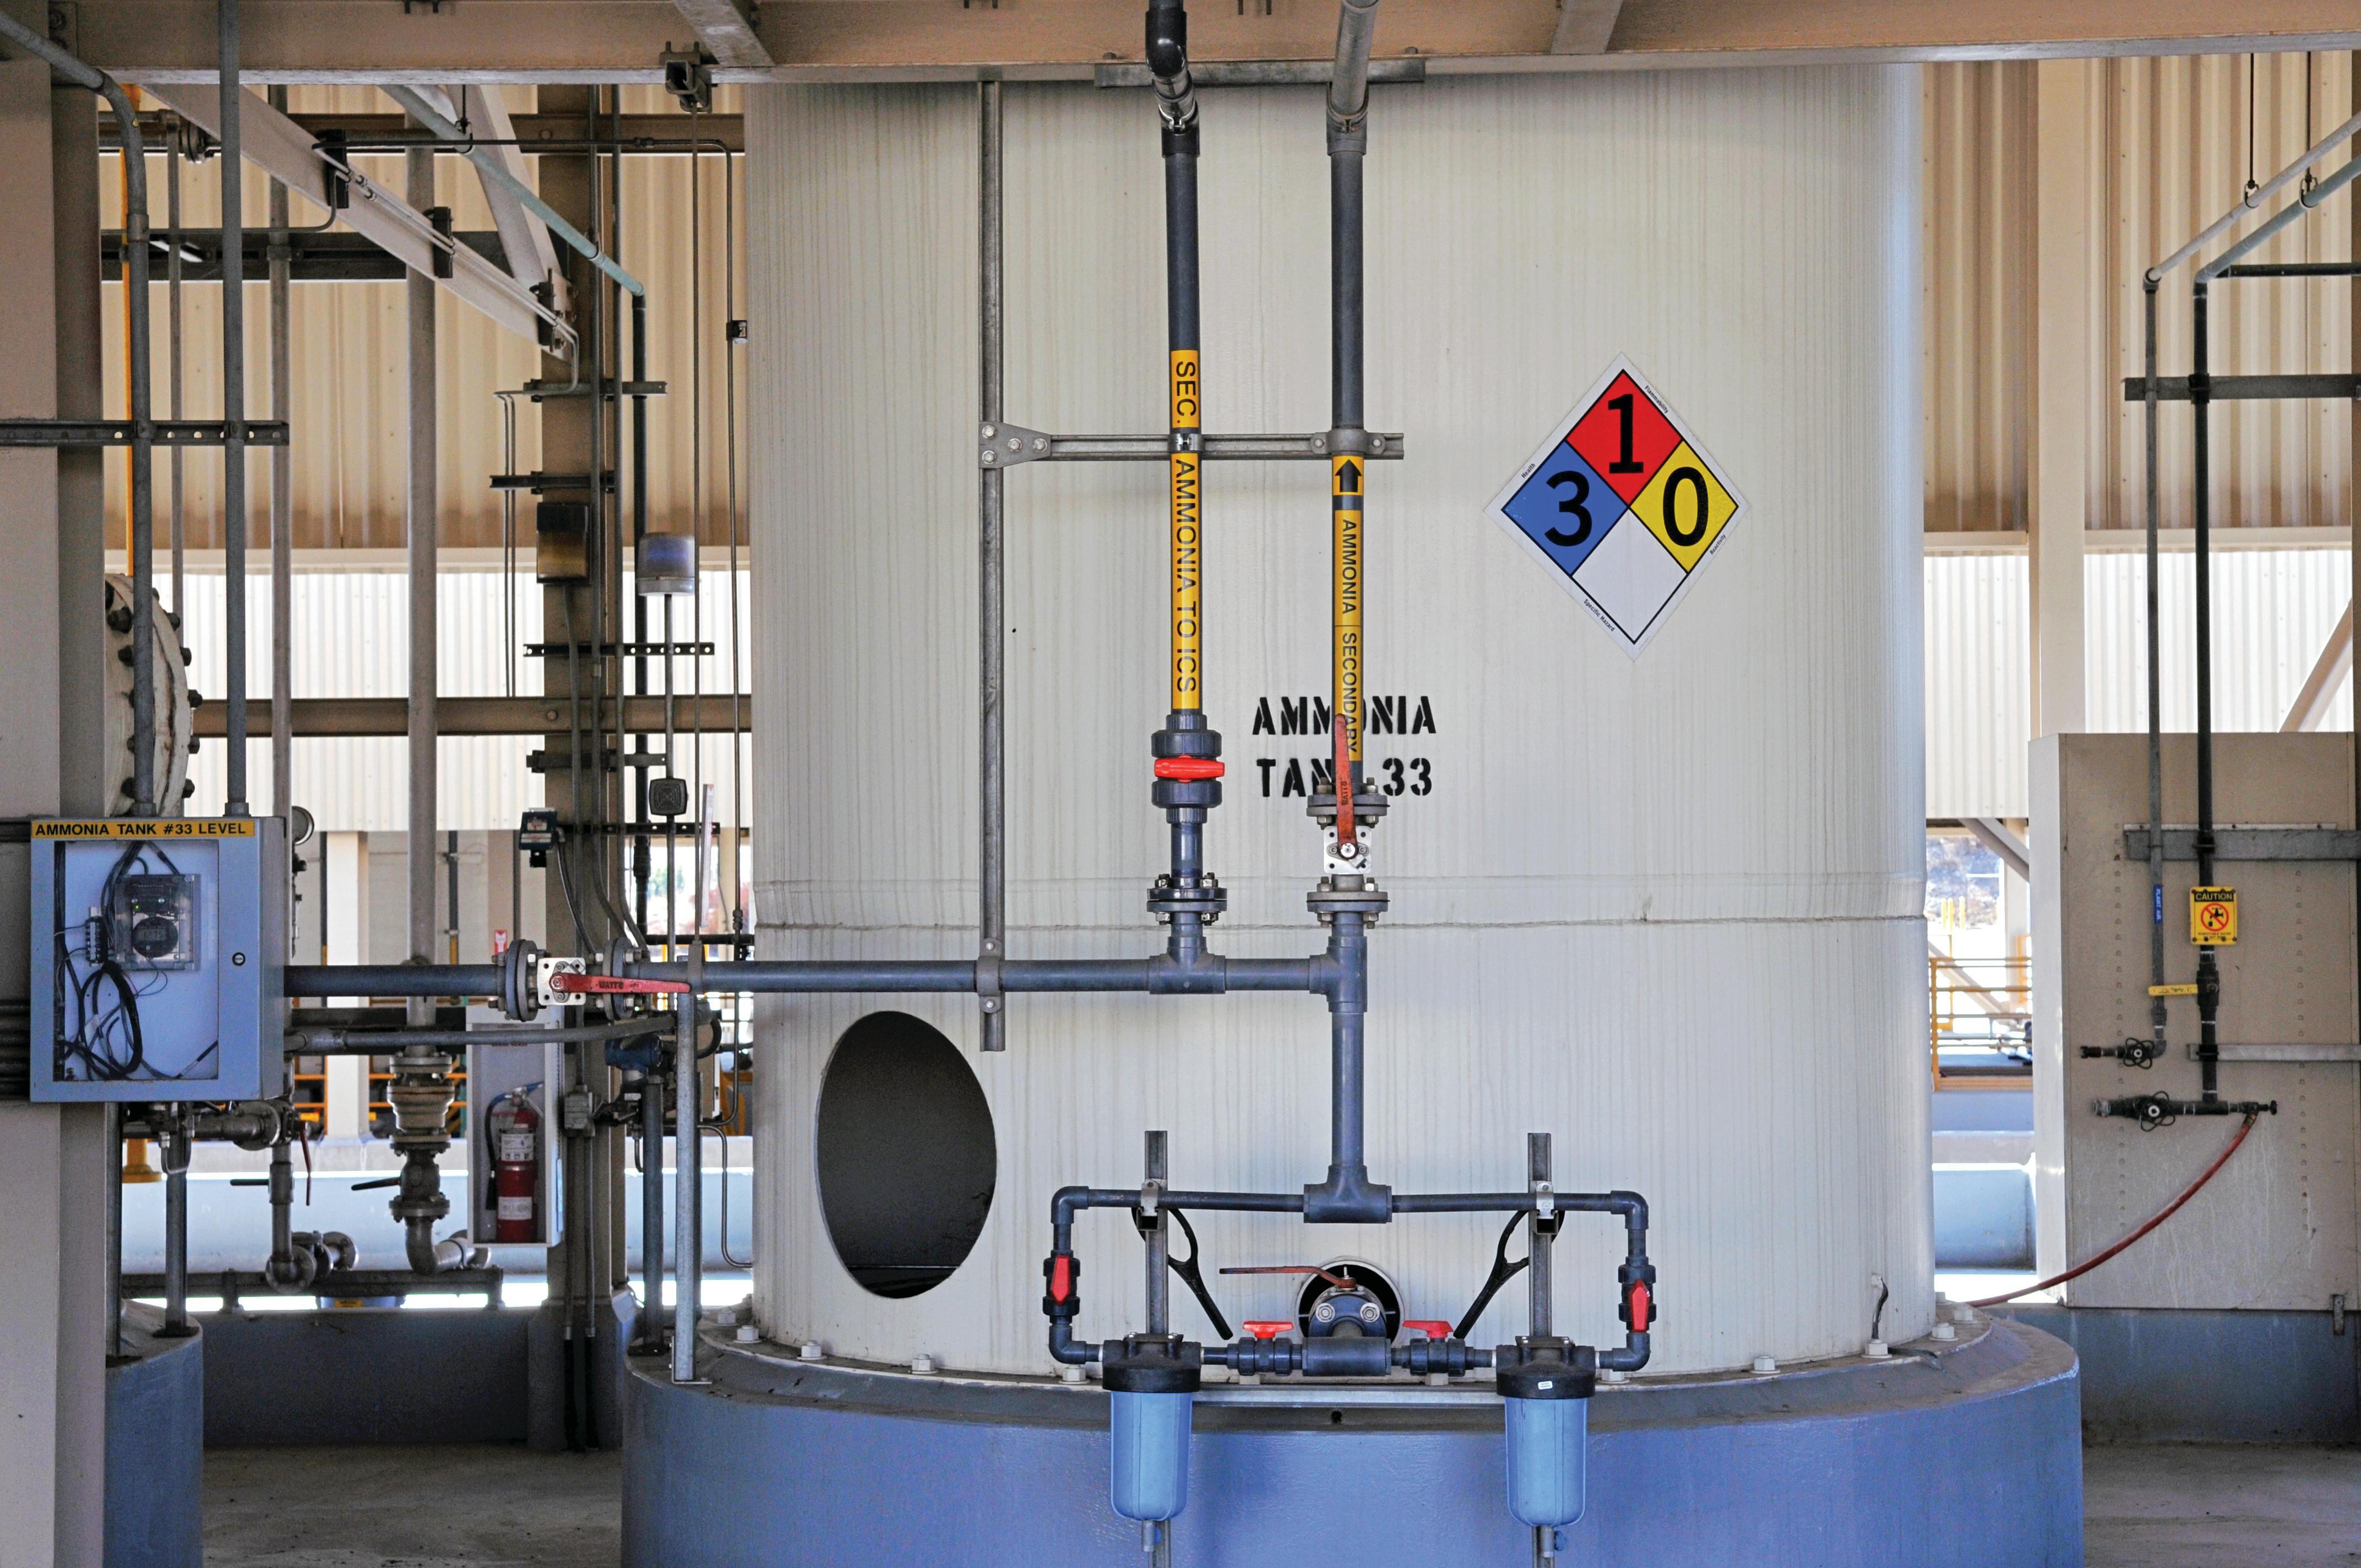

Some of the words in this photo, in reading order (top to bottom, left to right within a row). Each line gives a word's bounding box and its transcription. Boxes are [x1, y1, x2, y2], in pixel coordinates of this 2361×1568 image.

[1176, 361, 1196, 424] SEC.
[1644, 385, 1669, 414] Flammability
[1608, 394, 1644, 473] 1
[1521, 462, 1536, 478] Health
[1176, 459, 1197, 593] AMMONIA
[1544, 471, 1592, 547] 3
[1663, 466, 1709, 547] 0
[1709, 533, 1727, 555] Reactivity
[1342, 519, 1357, 615] AMMONIA
[1177, 601, 1197, 638] TO
[1583, 598, 1601, 617] Specific
[1599, 615, 1615, 633] Hazard
[1177, 649, 1197, 693] ICS
[1252, 695, 1436, 735] AMMNIA
[1256, 758, 1333, 797] TAN
[1383, 758, 1432, 797] 33
[35, 824, 110, 836] AMMONIA
[117, 824, 157, 835] TANK
[164, 823, 193, 835] #33
[198, 823, 247, 835] LEVEL
[2195, 892, 2233, 901] CAUTION
